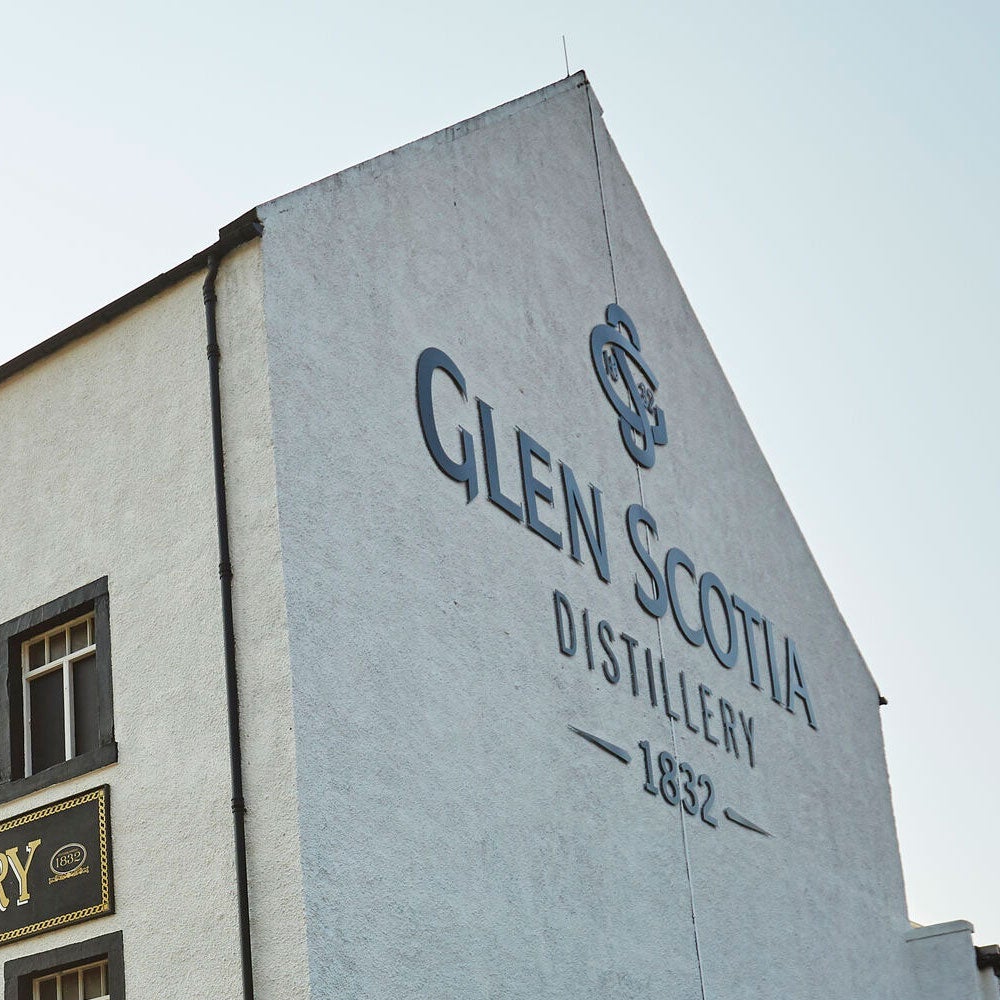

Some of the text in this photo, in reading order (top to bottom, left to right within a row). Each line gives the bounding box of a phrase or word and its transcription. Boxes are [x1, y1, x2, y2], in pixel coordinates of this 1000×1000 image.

[415, 346, 819, 731] GLEN SCOTIA
[554, 589, 757, 768] DISTILLERY
[638, 740, 718, 828] 1832
[55, 850, 81, 868] 1832
